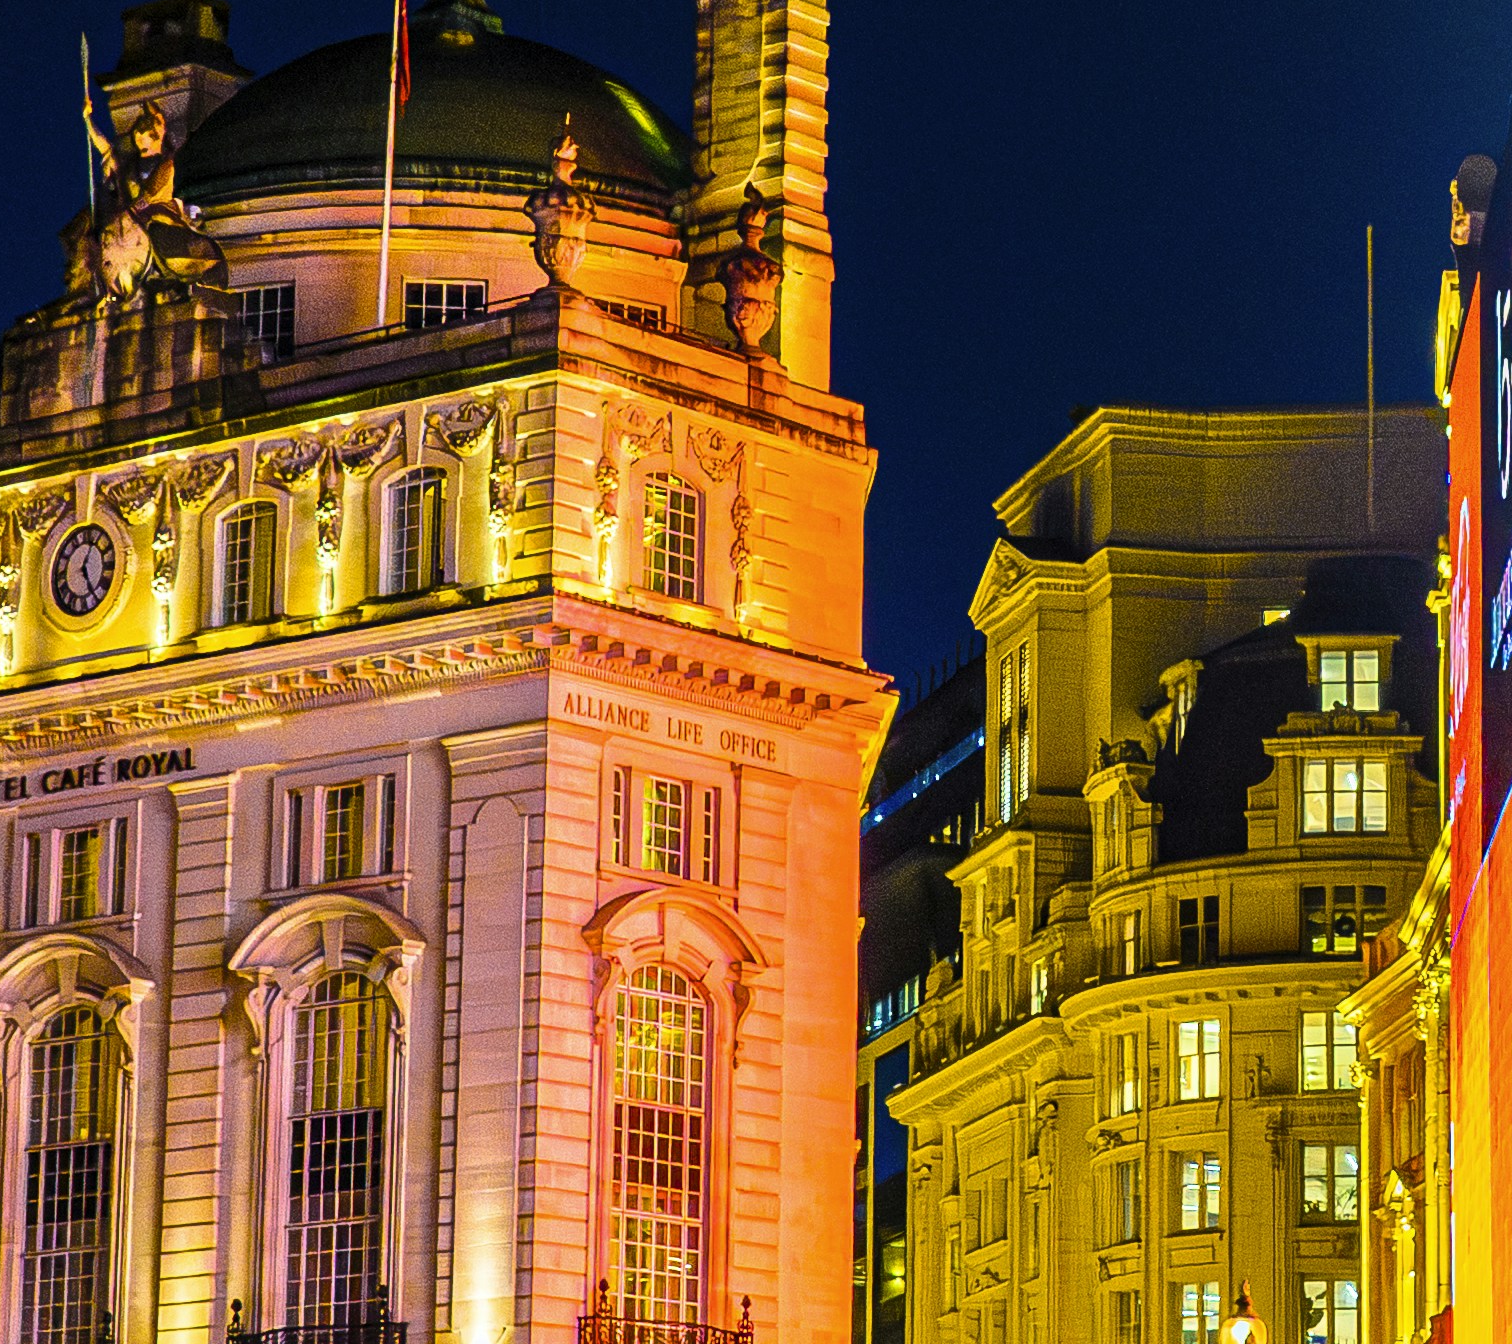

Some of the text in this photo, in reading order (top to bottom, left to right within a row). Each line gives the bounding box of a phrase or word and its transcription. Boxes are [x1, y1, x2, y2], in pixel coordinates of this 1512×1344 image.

[563, 692, 776, 762] ALLIANCE LIFE OFFICE
[40, 756, 107, 795] CAFÉ
[115, 746, 197, 783] ROYAL
